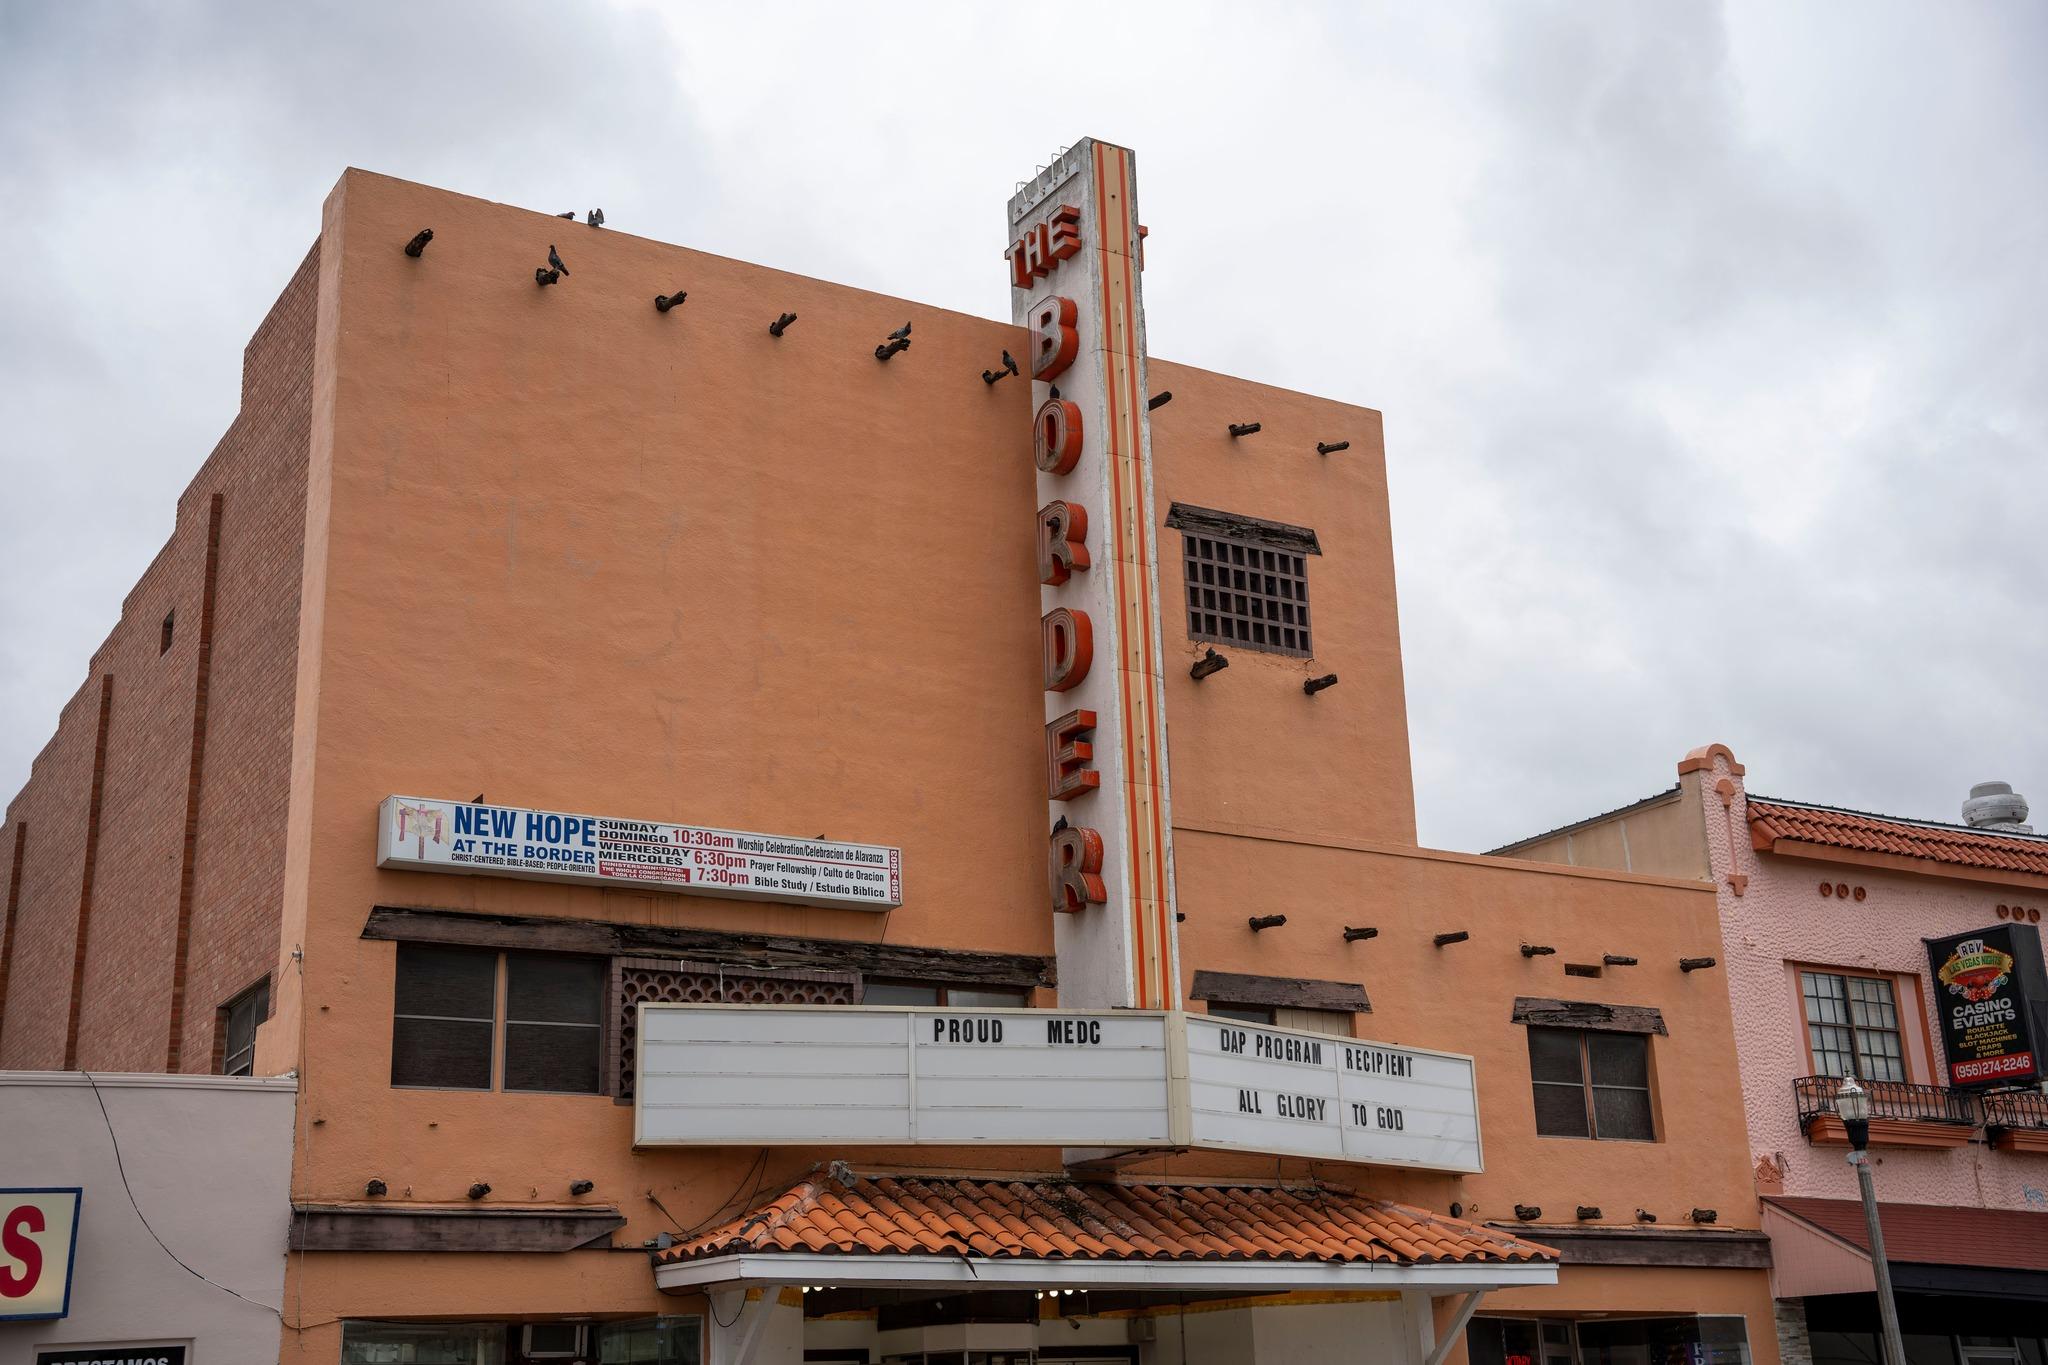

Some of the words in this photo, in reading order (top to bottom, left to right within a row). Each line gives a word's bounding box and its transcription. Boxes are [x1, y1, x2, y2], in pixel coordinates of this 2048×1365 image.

[1005, 204, 1082, 289] THE
[1028, 295, 1107, 914] BORDER
[454, 806, 517, 839] NEW
[526, 813, 596, 847] HOPE
[599, 820, 659, 833] SUNDAY
[599, 830, 668, 843] DOMINGO
[453, 839, 476, 853] AT
[482, 841, 518, 857] THE
[524, 845, 595, 864] BORDER
[599, 842, 691, 857] WEDNESDAY
[673, 829, 734, 848] 10:30am
[737, 838, 764, 853] Worship
[846, 849, 853, 861] de
[855, 850, 884, 863] Alavanza
[546, 862, 569, 871] PEOPLE
[568, 863, 596, 873] ORIENTED
[598, 851, 683, 866] MIERCOLES
[694, 851, 747, 869] 6:30pm
[750, 860, 774, 873] Prayer
[776, 862, 816, 878] Fellowship
[823, 867, 843, 878] Culto
[845, 870, 854, 879] de
[856, 870, 884, 882] Oracion
[638, 869, 686, 878] CONGREGATION
[697, 867, 749, 886] 7:30pm
[754, 876, 779, 888] Bible
[781, 879, 807, 892] Study
[809, 881, 813, 892] /
[816, 882, 850, 894] Estudio
[852, 885, 885, 898] Biblico
[890, 850, 899, 898] 369-3603
[1960, 943, 1982, 956] RGV
[1961, 957, 1981, 970] VEGAS
[1981, 955, 2001, 966] NIGHTS
[1953, 998, 2012, 1018] CASINO
[1952, 1009, 2016, 1030] EVENTS
[1966, 1023, 2005, 1034] ROULETTE
[934, 1018, 1003, 1043] PROUD
[1047, 1020, 1100, 1044] MEDC
[1959, 1040, 1978, 1049] SLOT
[1979, 1033, 2018, 1045] MACHINES
[1965, 1029, 2009, 1041] BLACKJACK
[1220, 1028, 1246, 1054] DAP
[1256, 1034, 1322, 1065] PROGRAM
[1345, 1048, 1413, 1078] RECIPIENT
[1976, 1043, 2002, 1052] CRAPS
[1983, 1049, 2005, 1057] MORE
[1955, 1055, 2030, 1079] (956)274-2246
[1239, 1089, 1262, 1114] ALL
[1277, 1094, 1326, 1121] GLORY
[1352, 1103, 1368, 1127] TO
[1377, 1107, 1404, 1131] GOD
[0, 1205, 46, 1298] S
